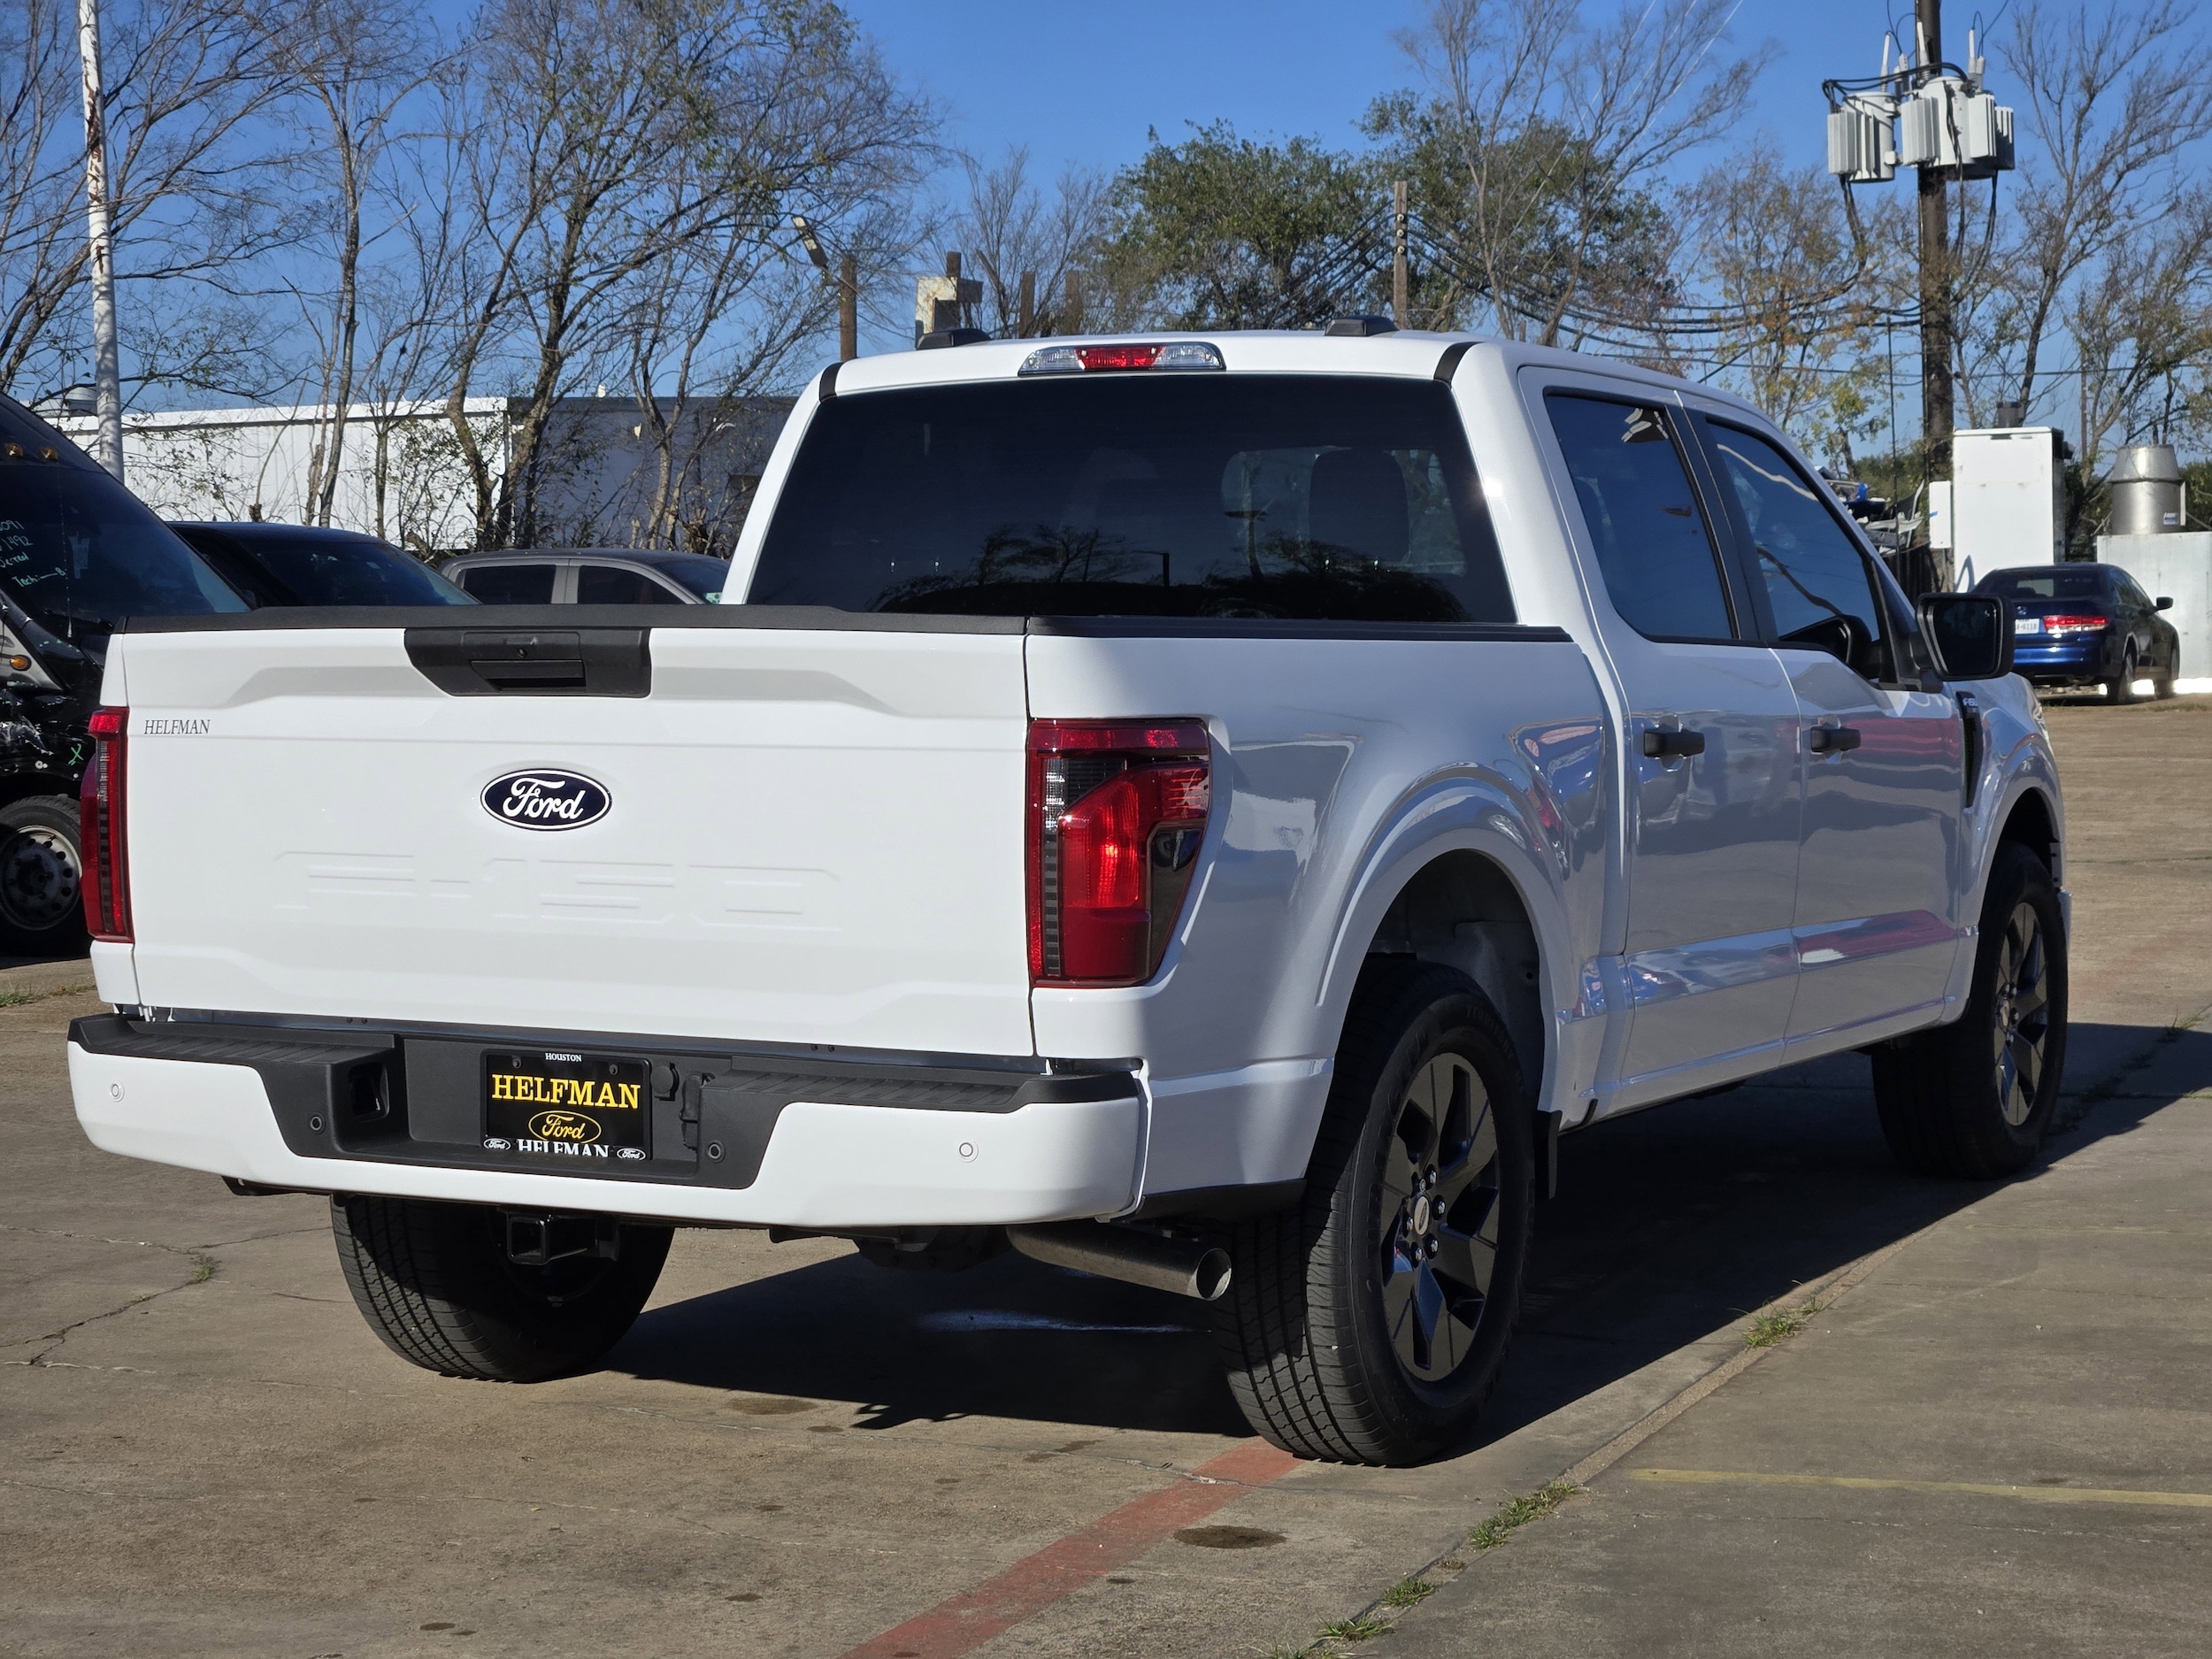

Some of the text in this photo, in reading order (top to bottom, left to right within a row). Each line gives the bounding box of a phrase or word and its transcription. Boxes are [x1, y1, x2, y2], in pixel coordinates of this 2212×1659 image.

[143, 718, 211, 735] HELFMAN
[502, 777, 587, 819] Ford
[545, 1052, 582, 1063] HOUSTON
[491, 1073, 641, 1110] HELFMAN
[541, 1113, 587, 1140] Ford
[516, 1138, 610, 1158] HELFMAN
